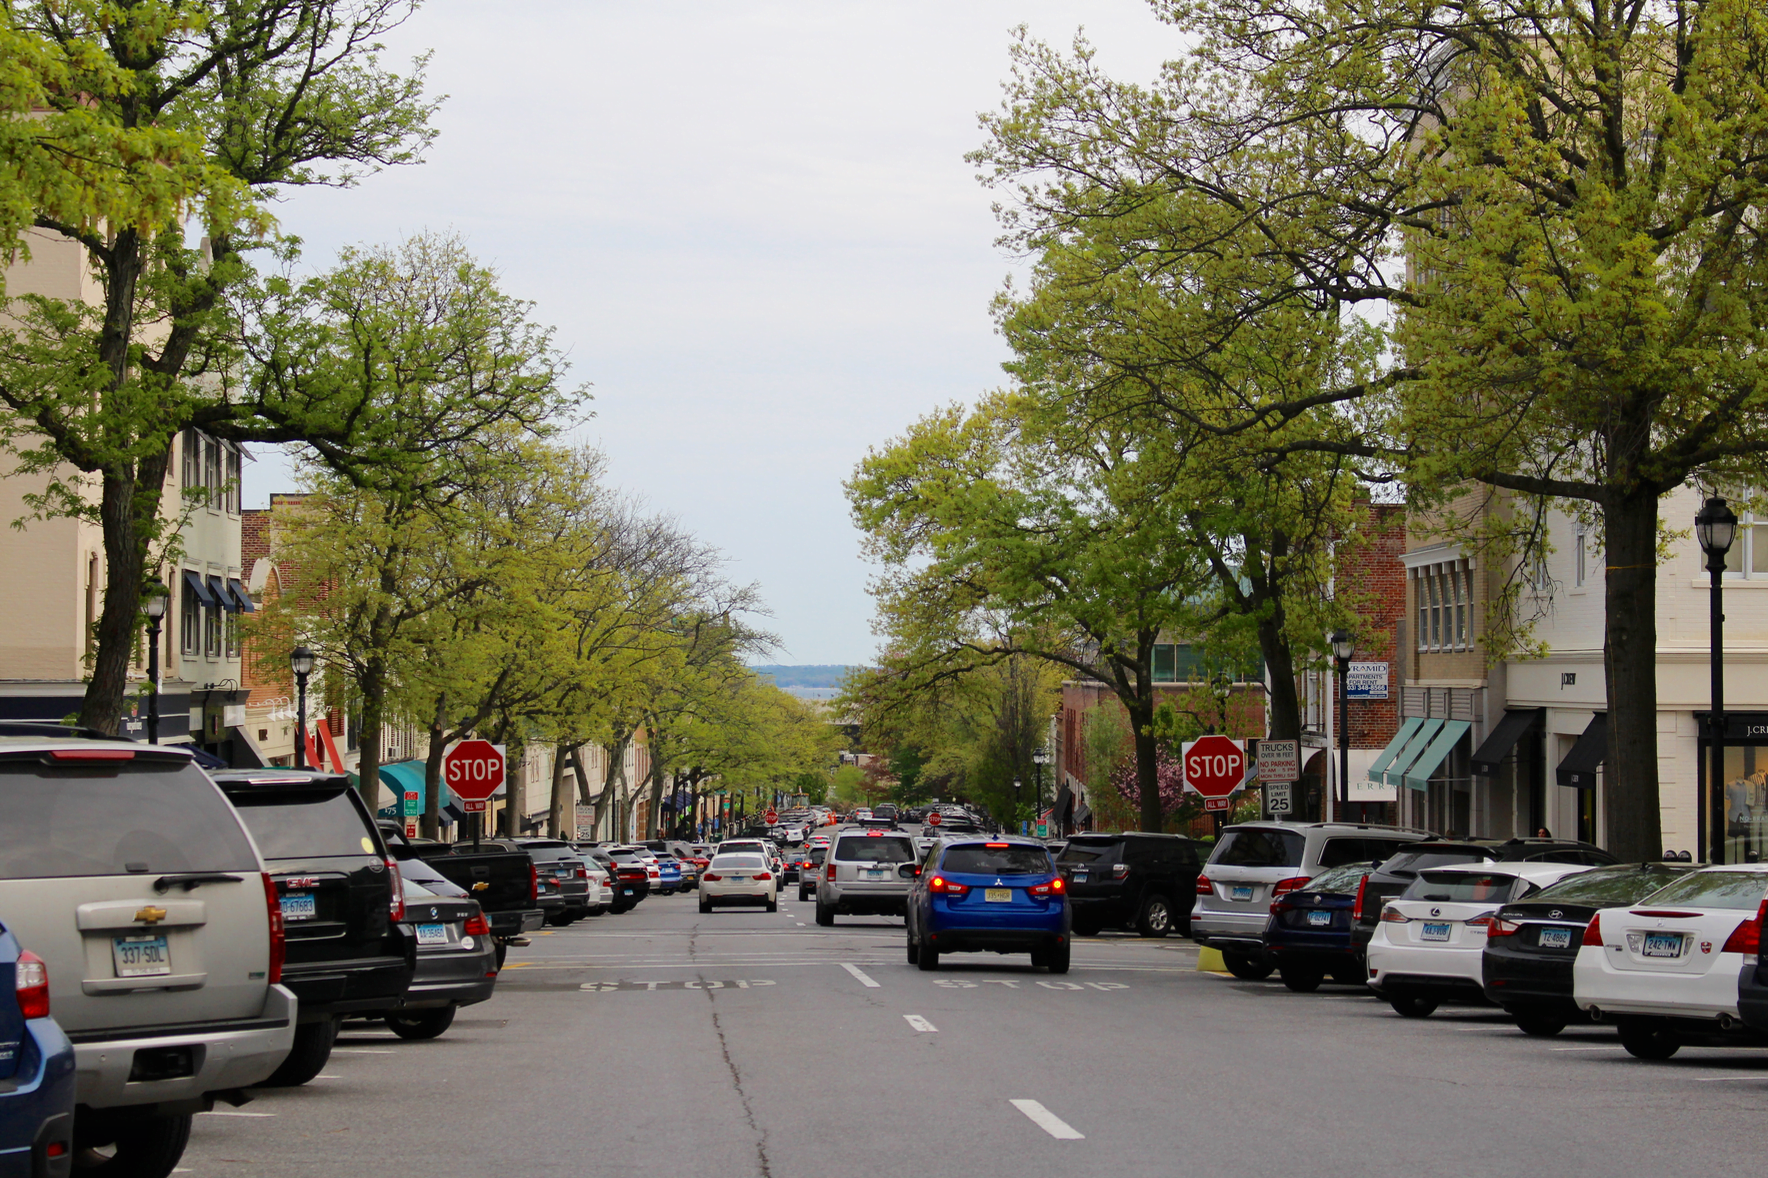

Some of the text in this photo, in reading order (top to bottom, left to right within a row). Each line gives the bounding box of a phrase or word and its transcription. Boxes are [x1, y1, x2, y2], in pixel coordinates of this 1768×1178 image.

[1260, 743, 1294, 752] TRUCKS
[448, 758, 500, 782] STOP
[1189, 754, 1241, 779] STOP
[1259, 760, 1270, 768] NO
[1270, 798, 1289, 811] 25
[286, 876, 320, 889] GMC
[579, 979, 777, 992] STOP
[932, 979, 1131, 991] STOP
